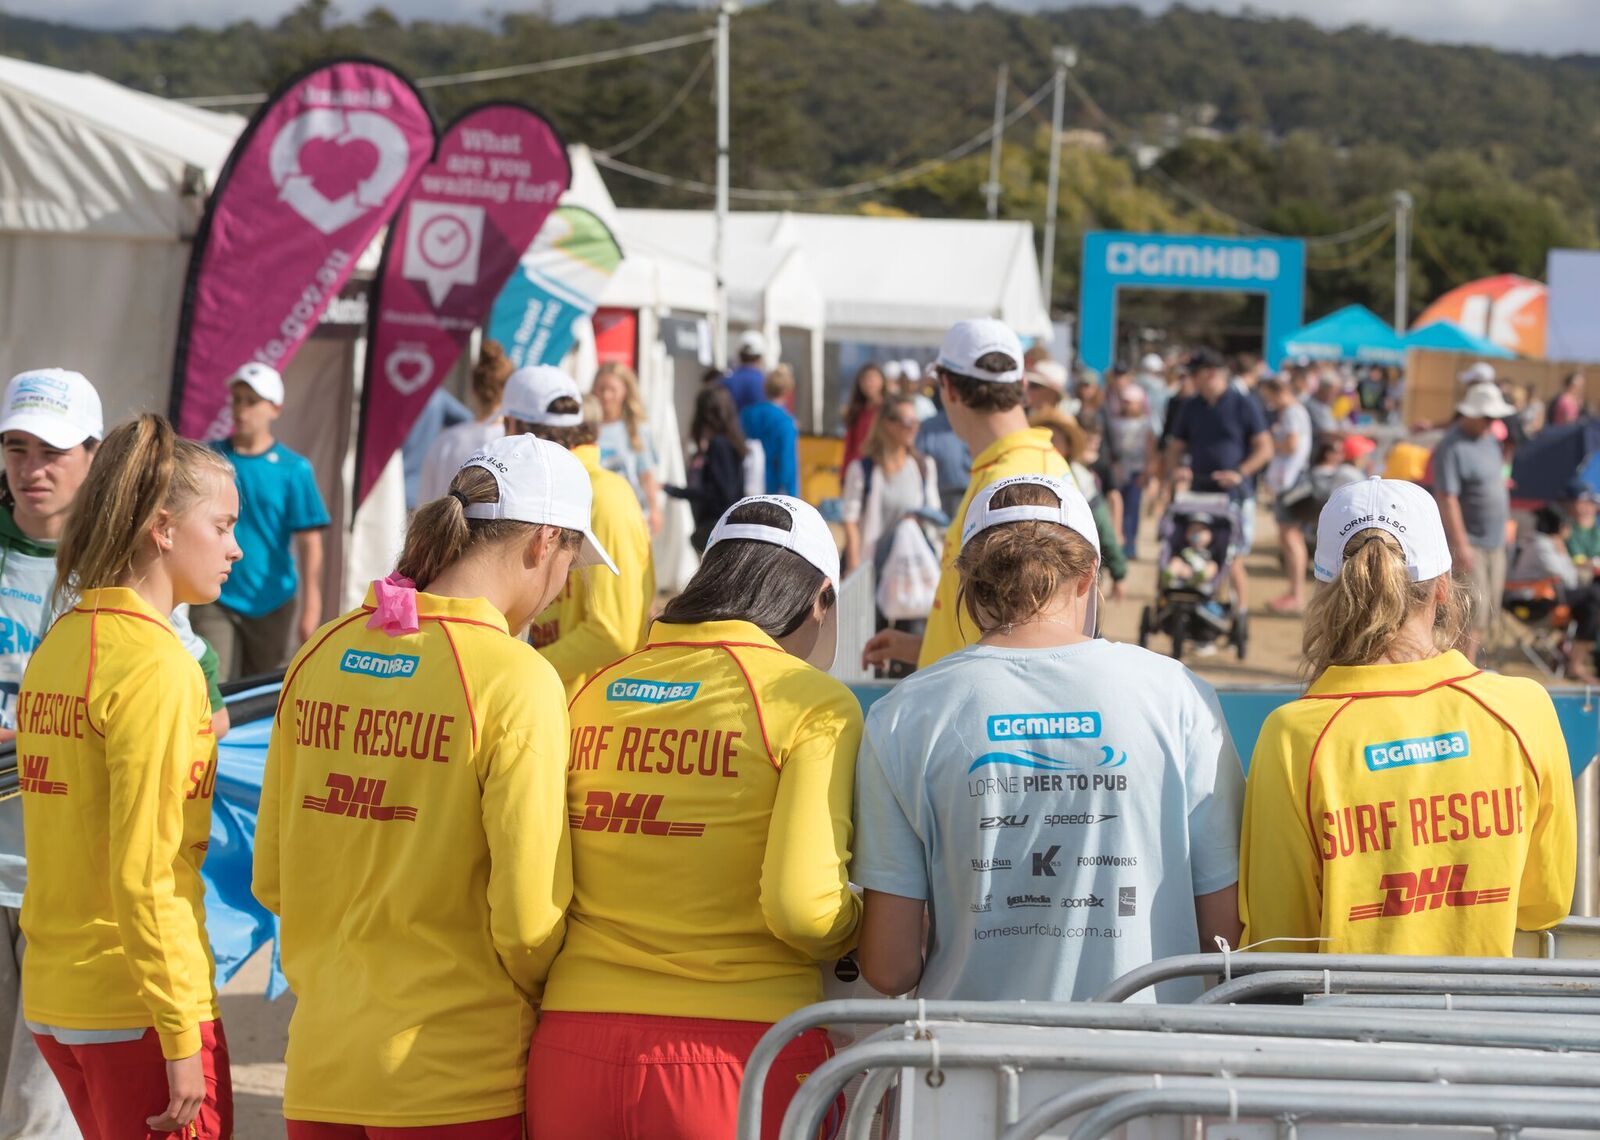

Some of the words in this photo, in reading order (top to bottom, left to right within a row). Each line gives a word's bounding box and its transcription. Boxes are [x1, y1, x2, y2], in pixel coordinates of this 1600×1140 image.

[461, 128, 520, 153] What
[487, 456, 508, 474] SLSC
[1339, 514, 1374, 536] LORNE
[1377, 515, 1407, 534] SLSC
[29, 692, 86, 739] RESCUE
[353, 708, 455, 763] RESCUE
[616, 726, 742, 778] RESCUE
[324, 772, 396, 821] DHL
[968, 776, 1018, 797] LORNE
[1023, 775, 1063, 792] PIER
[1067, 774, 1088, 791] TO
[1092, 774, 1127, 791] PUB
[581, 790, 671, 836] DHL
[980, 815, 1029, 828] 2XU
[1044, 812, 1095, 827] speedo
[1322, 801, 1397, 860] SURF
[992, 857, 1012, 866] Sun
[1379, 864, 1478, 918] DHL
